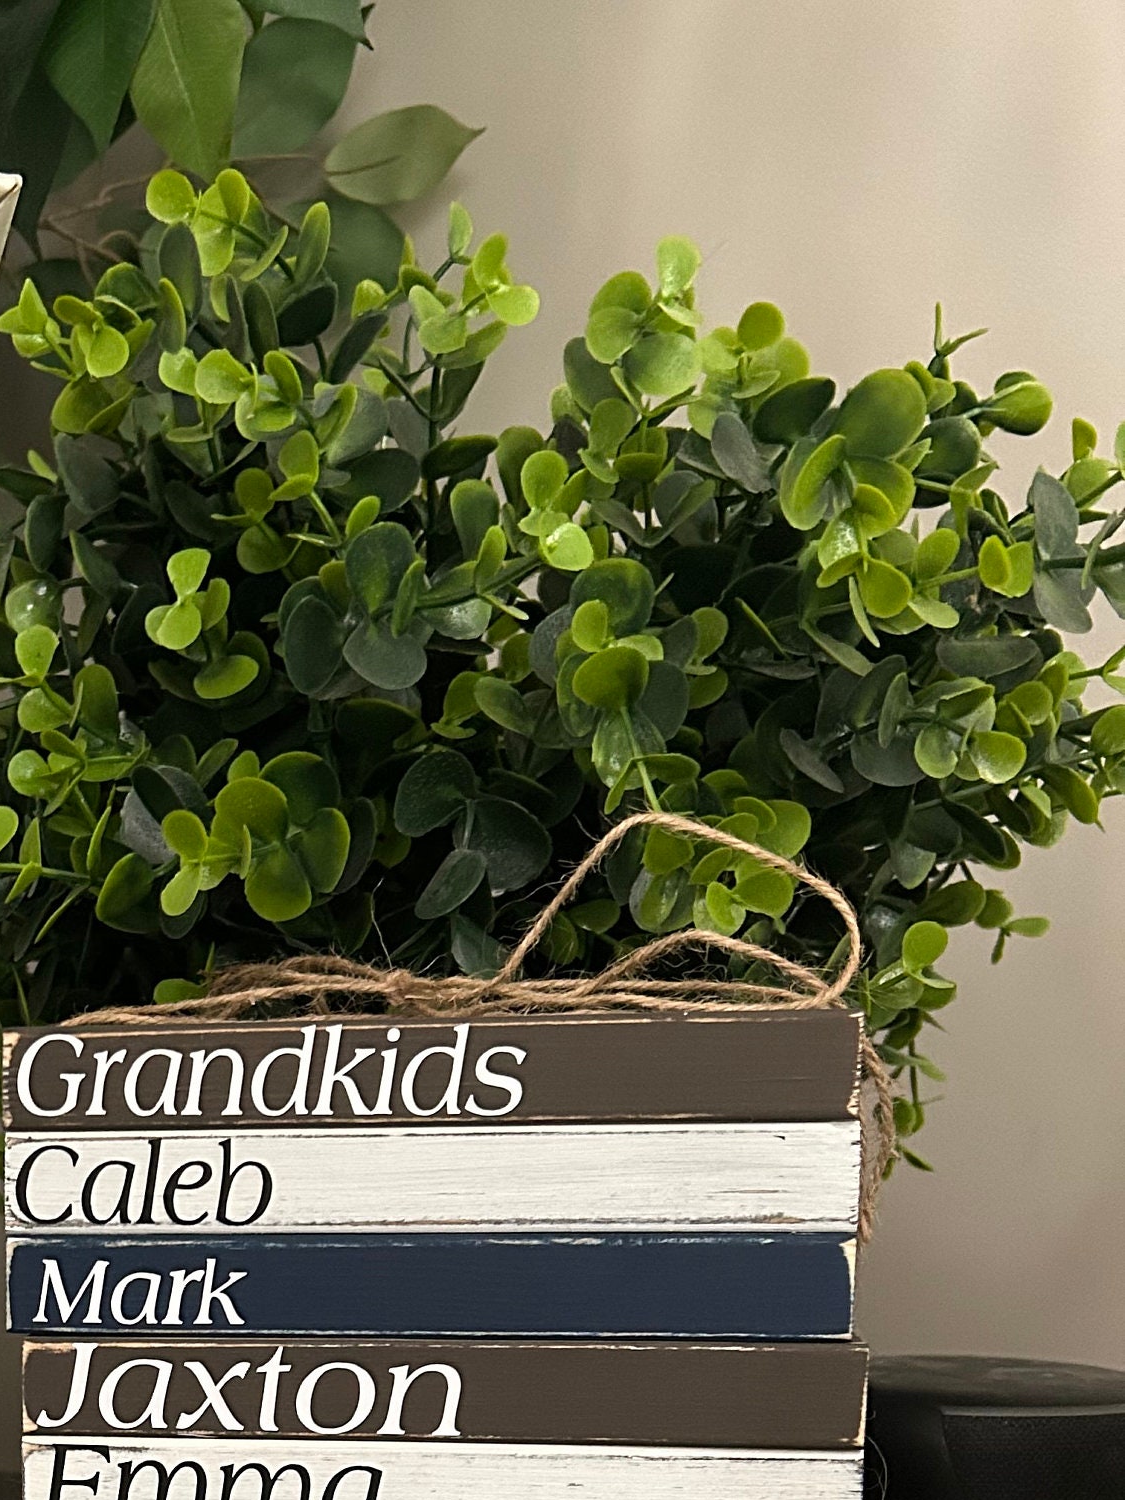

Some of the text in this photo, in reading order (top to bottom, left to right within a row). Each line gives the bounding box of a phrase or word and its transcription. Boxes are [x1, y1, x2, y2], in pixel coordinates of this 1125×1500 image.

[16, 1025, 527, 1117] Grandkids
[14, 1140, 272, 1226] Caleb
[32, 1258, 247, 1326] Mark
[36, 1342, 463, 1436] Jaxton
